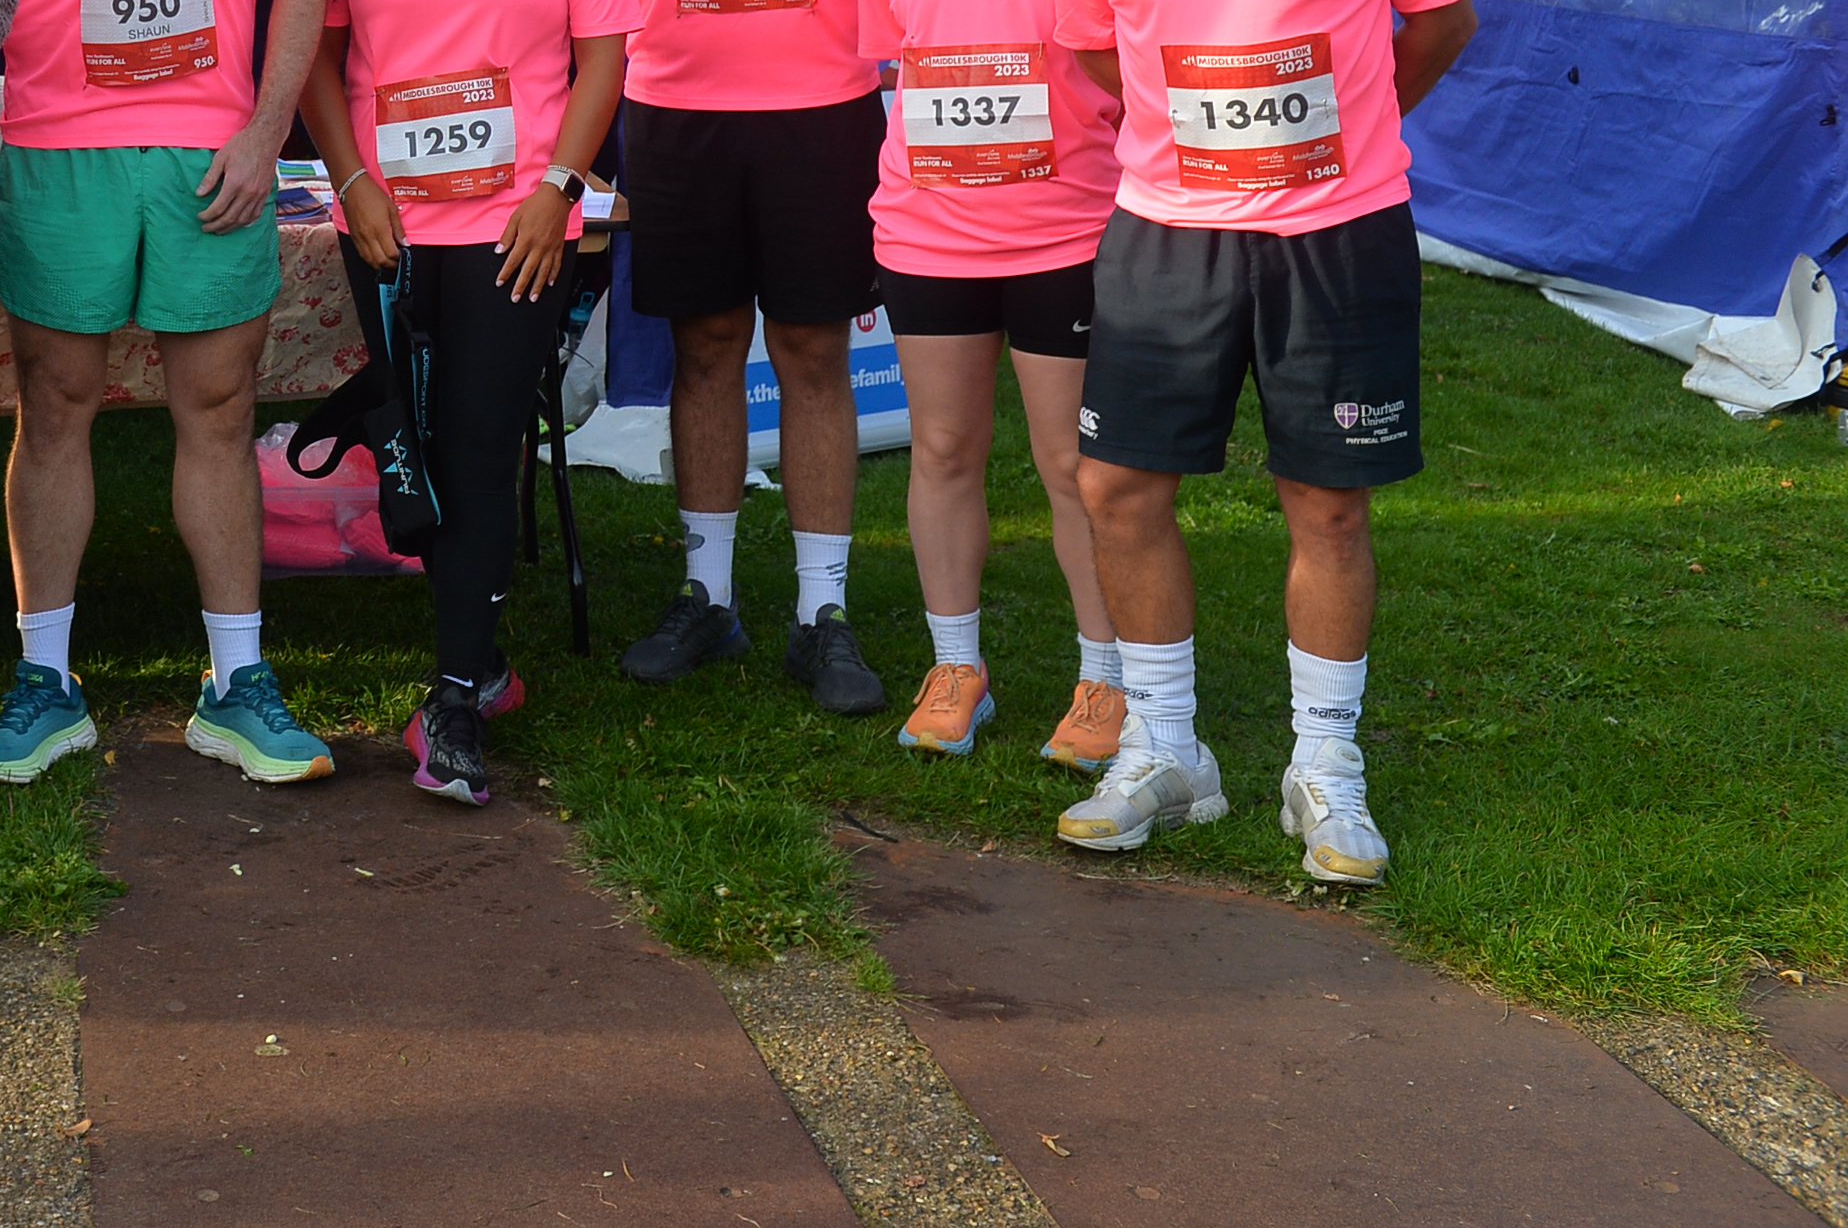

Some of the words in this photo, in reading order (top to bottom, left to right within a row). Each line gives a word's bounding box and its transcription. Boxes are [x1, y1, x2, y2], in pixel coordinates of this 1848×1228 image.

[128, 24, 171, 40] SHAUN
[193, 55, 215, 69] 950
[932, 54, 1008, 66] MIDDLESBROUGH
[1009, 53, 1027, 62] 10K
[1198, 51, 1290, 66] MIDDLESBROUGH
[1291, 46, 1310, 58] 10K
[994, 64, 1030, 77] 2023
[1275, 57, 1314, 76] 2023
[402, 81, 475, 100] MIDDLESBROUGH
[476, 78, 492, 89] 10K
[462, 88, 495, 104] 2023
[931, 96, 1021, 127] 1337
[1200, 92, 1309, 130] 1340
[404, 119, 492, 158] 1259
[928, 160, 941, 168] FOR
[941, 160, 953, 168] ALL
[1020, 164, 1052, 179] 1337
[1182, 159, 1198, 169] RUN
[1198, 161, 1214, 170] FOR
[1214, 163, 1229, 172] ALL
[1306, 163, 1340, 181] 1340
[1237, 181, 1268, 190] Baggage
[1268, 179, 1287, 187] label
[851, 363, 904, 388] efamil
[1361, 400, 1405, 417] Durham
[1361, 413, 1401, 427] University
[1345, 437, 1379, 445] PHYSICAL
[1380, 430, 1408, 443] EDUCATION
[1373, 428, 1389, 436] PGCE
[390, 438, 411, 495] RUNITUDE
[1308, 706, 1356, 720] adidas
